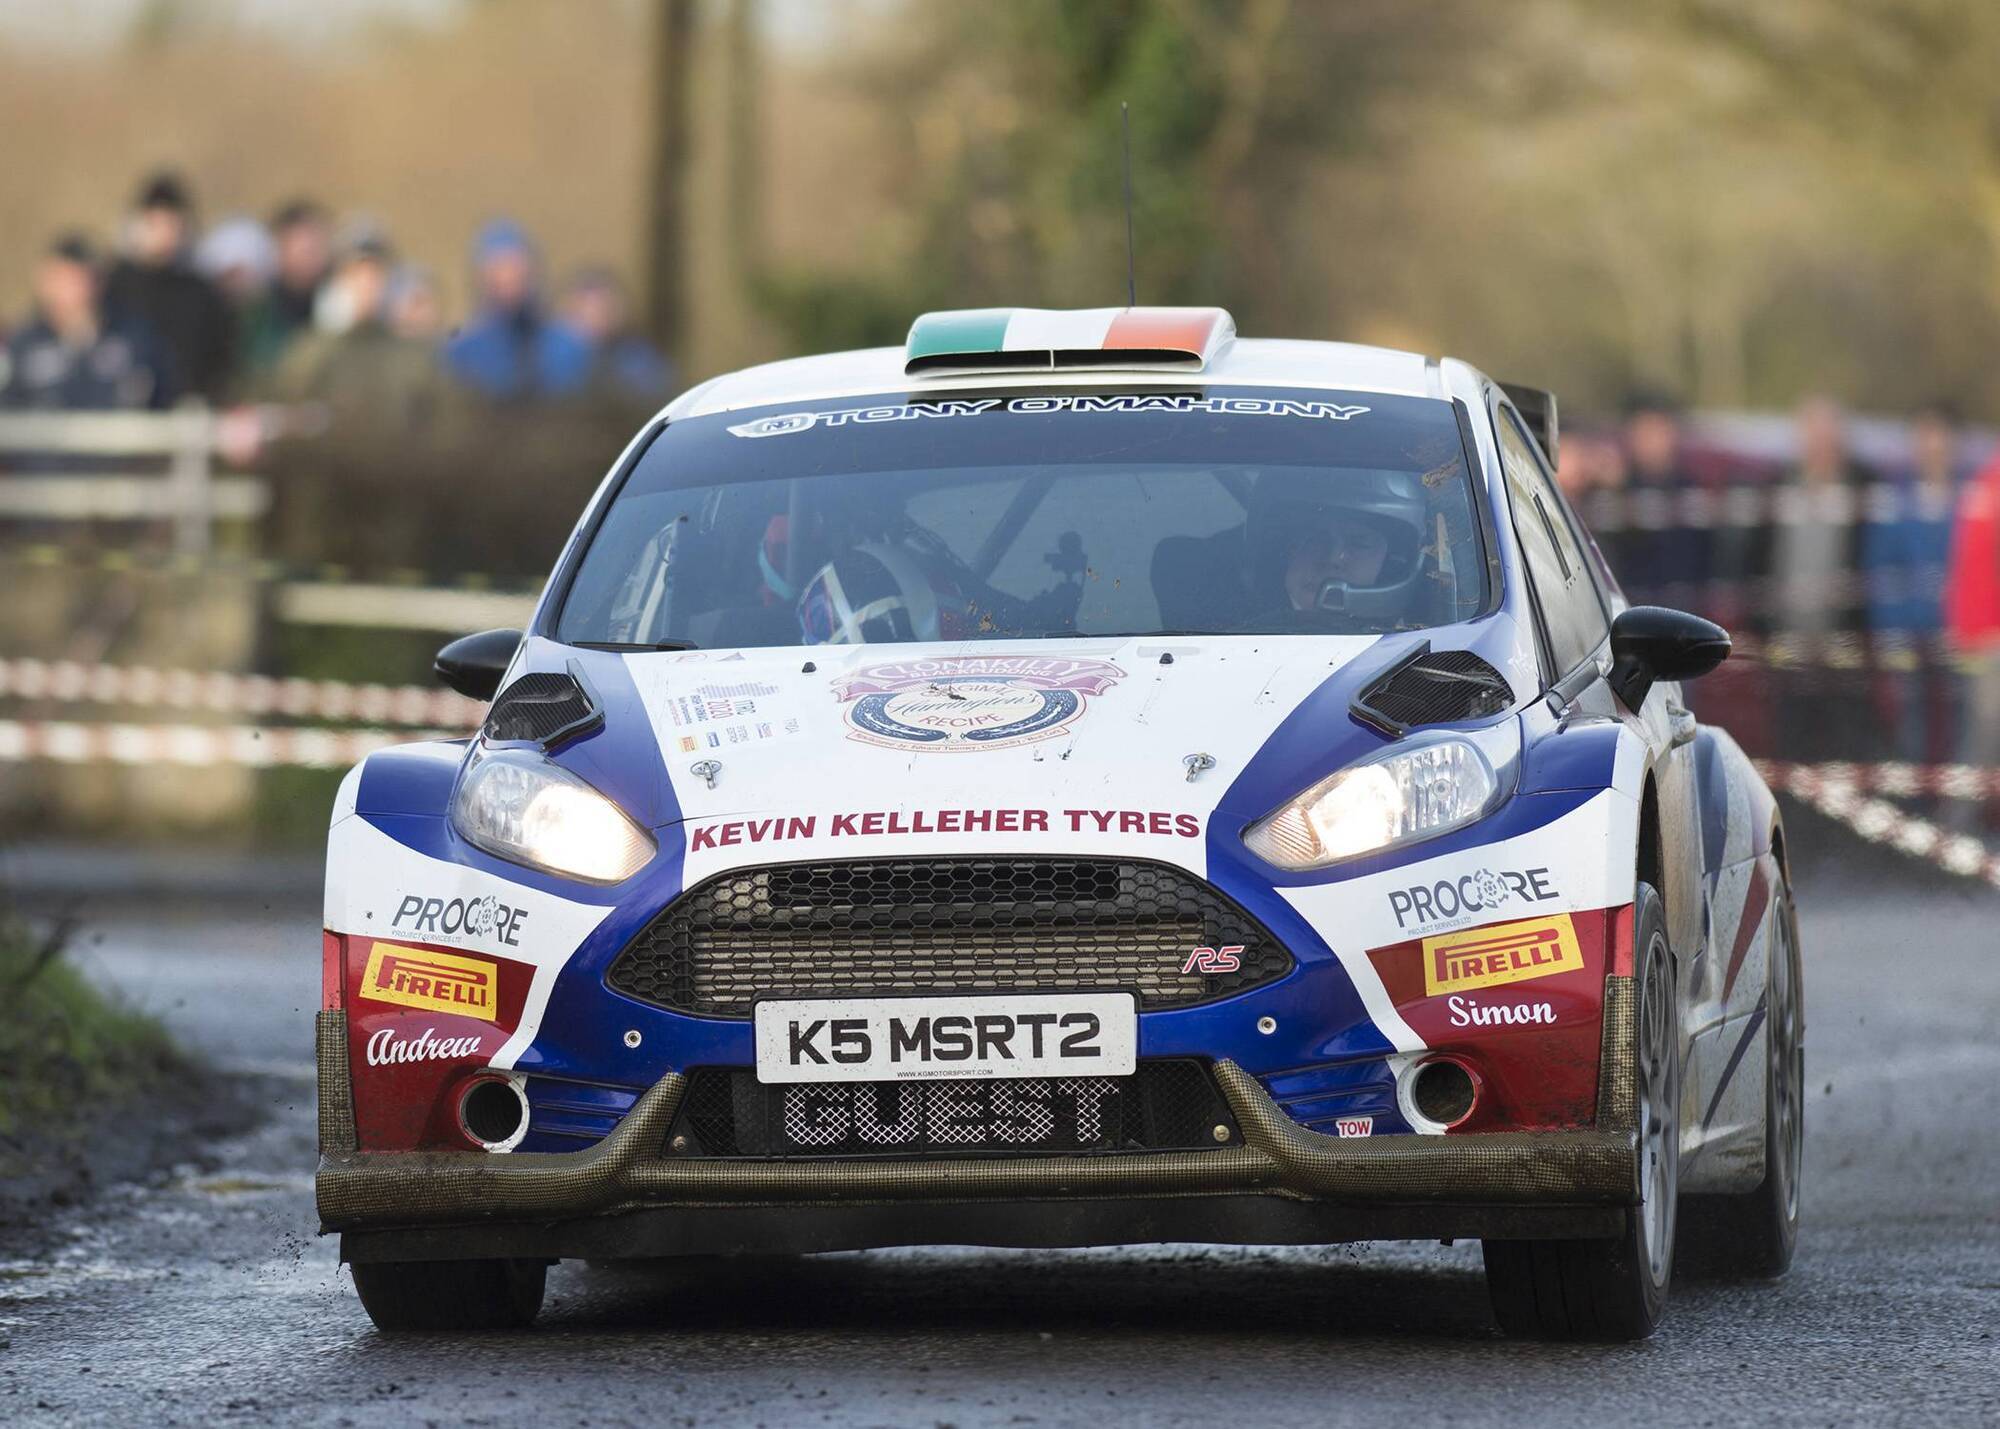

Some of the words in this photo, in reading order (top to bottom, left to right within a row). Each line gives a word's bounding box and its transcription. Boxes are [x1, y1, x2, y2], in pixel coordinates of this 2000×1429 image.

[817, 399, 1001, 426] TONY
[1008, 396, 1370, 420] O'MAHONY
[867, 659, 1099, 679] CLONAKILTY
[918, 713, 1005, 727] RECIPE
[691, 815, 815, 852] KEVIN
[831, 809, 1049, 836] KELLEHER
[1064, 809, 1200, 838] TYRES
[1434, 928, 1563, 982] PIRELLI
[375, 954, 488, 1007] PIRELLI
[1448, 996, 1557, 1026] Simon
[367, 1028, 482, 1066] Andrew
[789, 1018, 872, 1065] K5
[890, 1012, 1101, 1062] MSRT2
[785, 1080, 1120, 1145] GUEST
[1339, 1121, 1371, 1136] TOW
